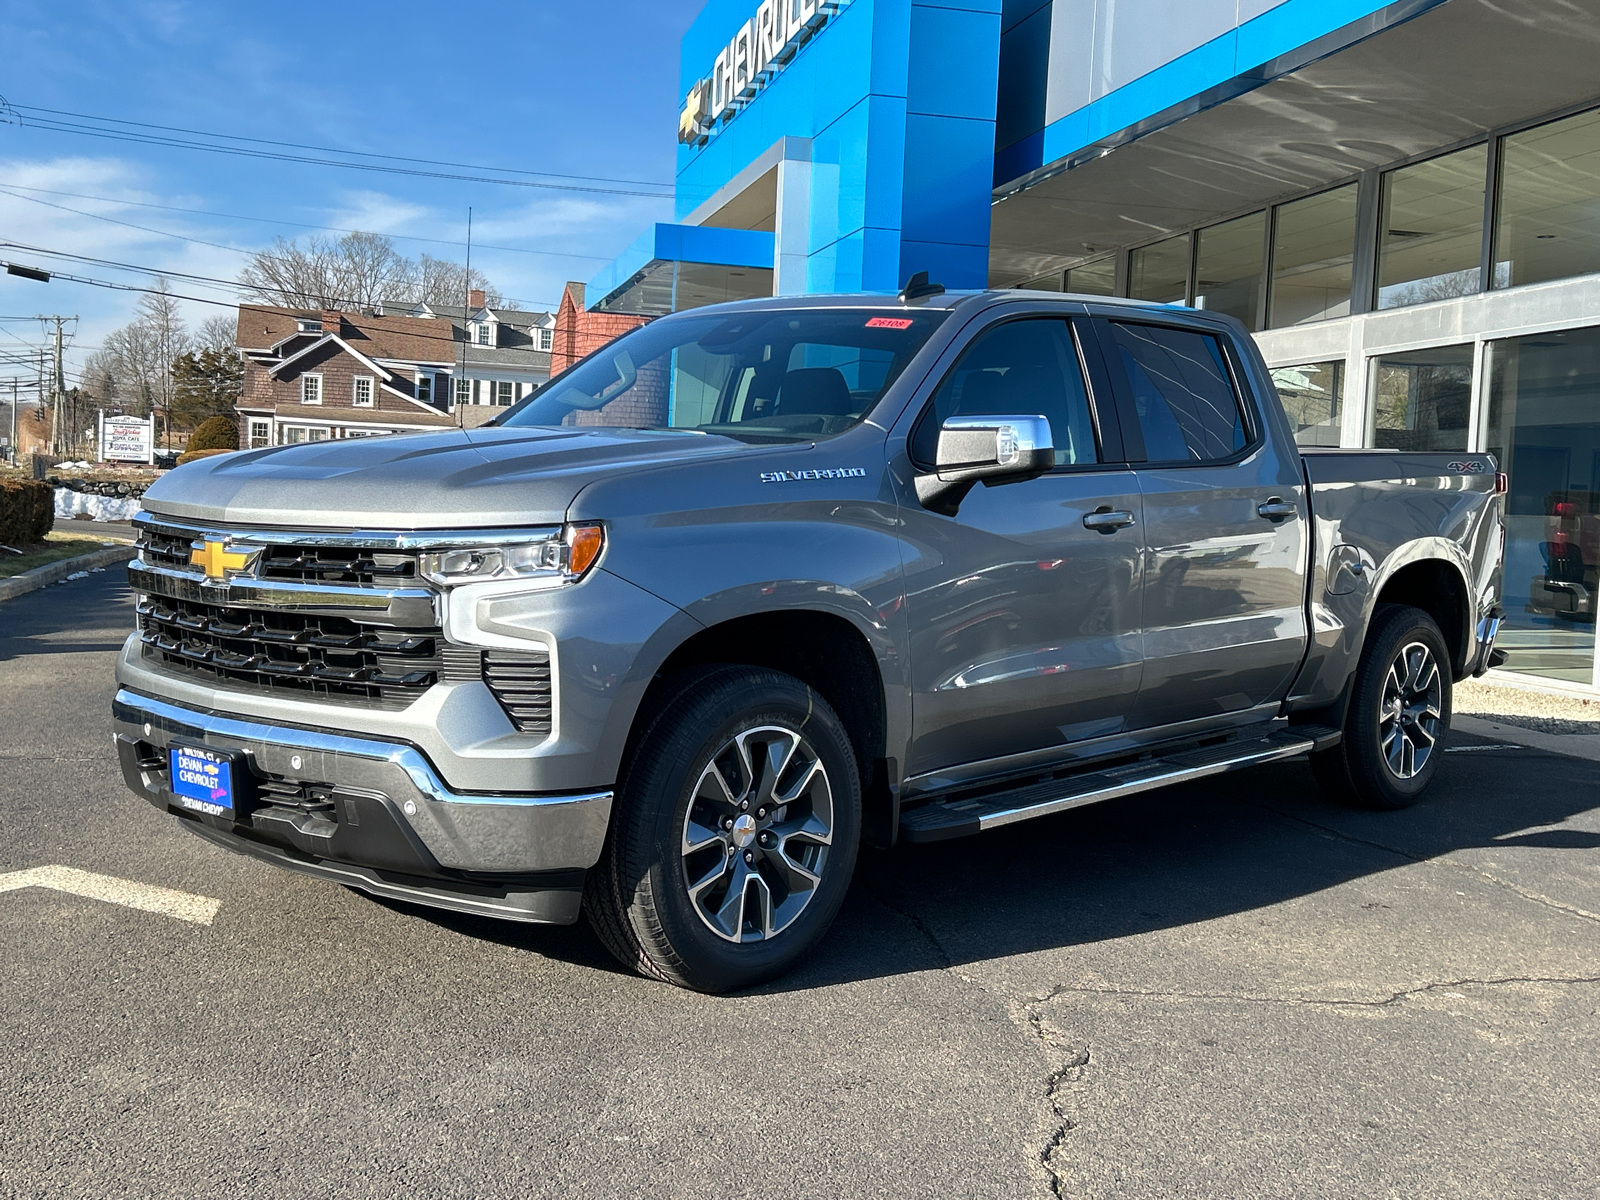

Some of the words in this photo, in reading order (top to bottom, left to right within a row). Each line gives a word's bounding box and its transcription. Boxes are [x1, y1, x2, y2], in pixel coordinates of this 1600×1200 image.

[760, 467, 866, 483] SILVERADO
[178, 756, 203, 773] DEVAN
[206, 752, 214, 762] CT
[179, 770, 218, 789] CHEVROLET
